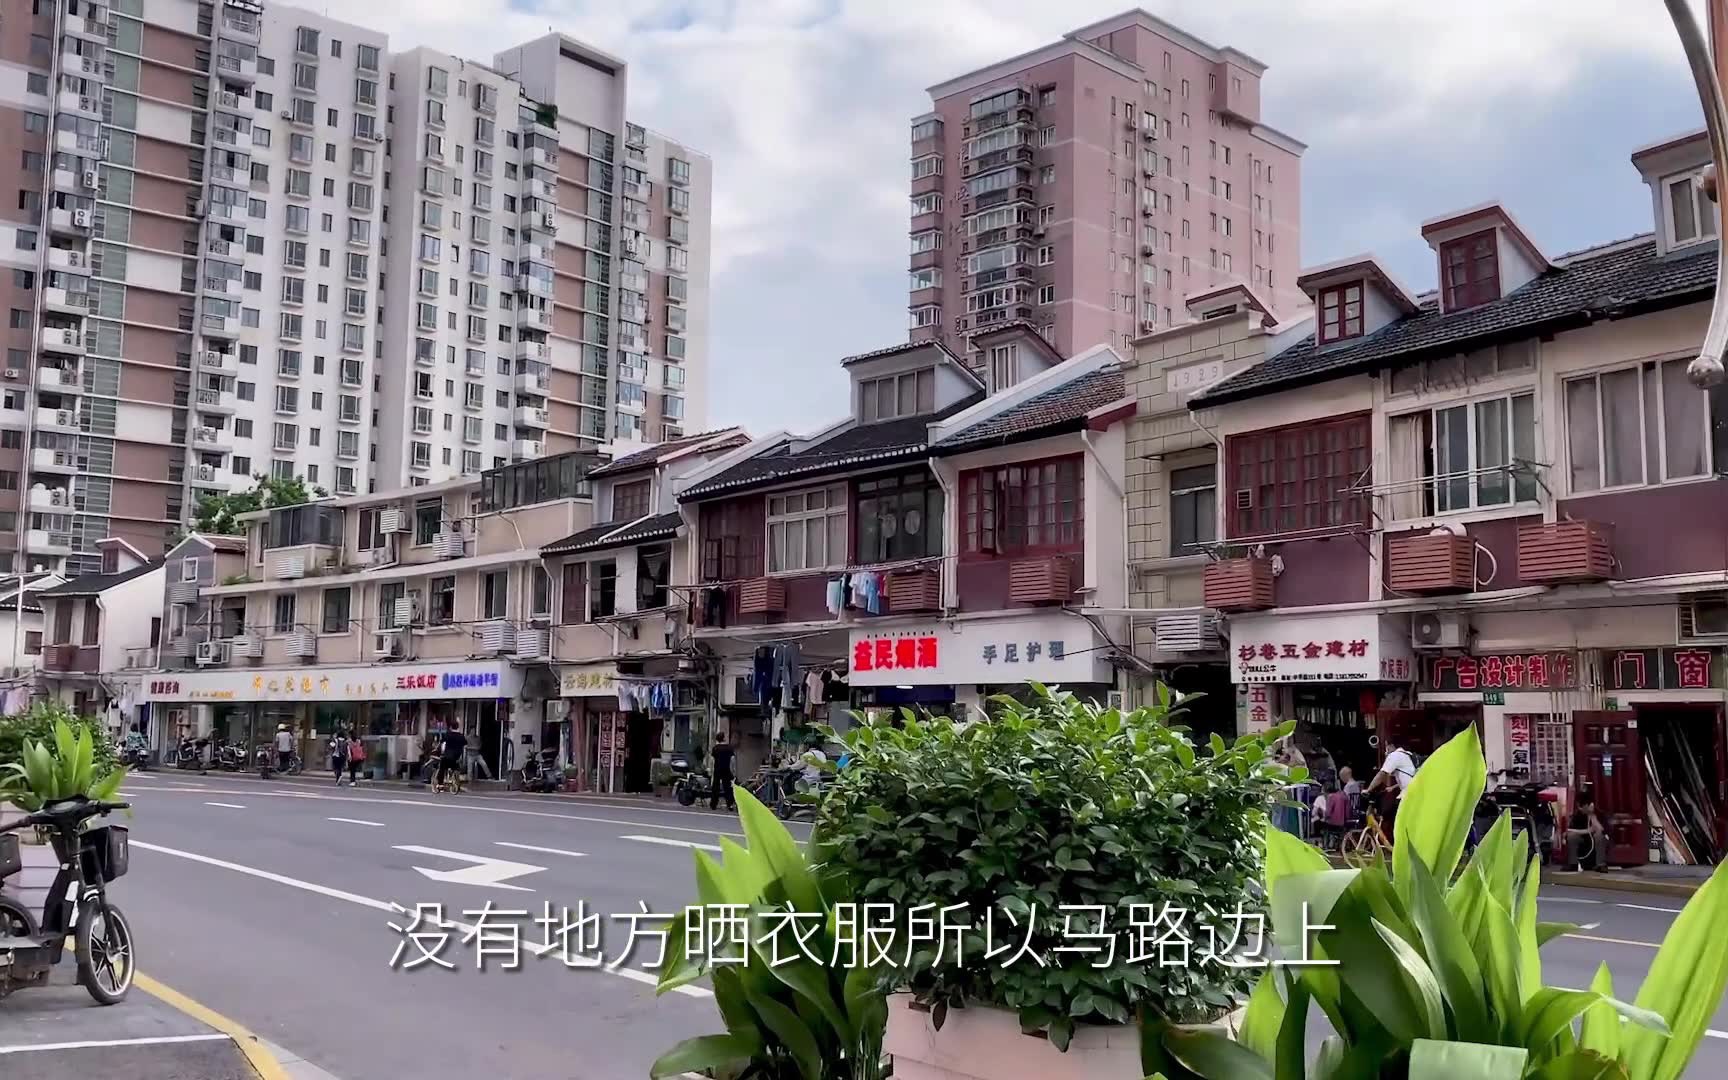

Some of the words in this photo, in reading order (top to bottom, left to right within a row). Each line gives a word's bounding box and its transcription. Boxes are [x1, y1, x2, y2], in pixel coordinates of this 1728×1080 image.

[854, 637, 938, 671] 益民烟酒
[982, 640, 1065, 664] 手足护理
[1238, 639, 1369, 661] 杉巷五金建材
[1433, 654, 1576, 689] 广告设计制作
